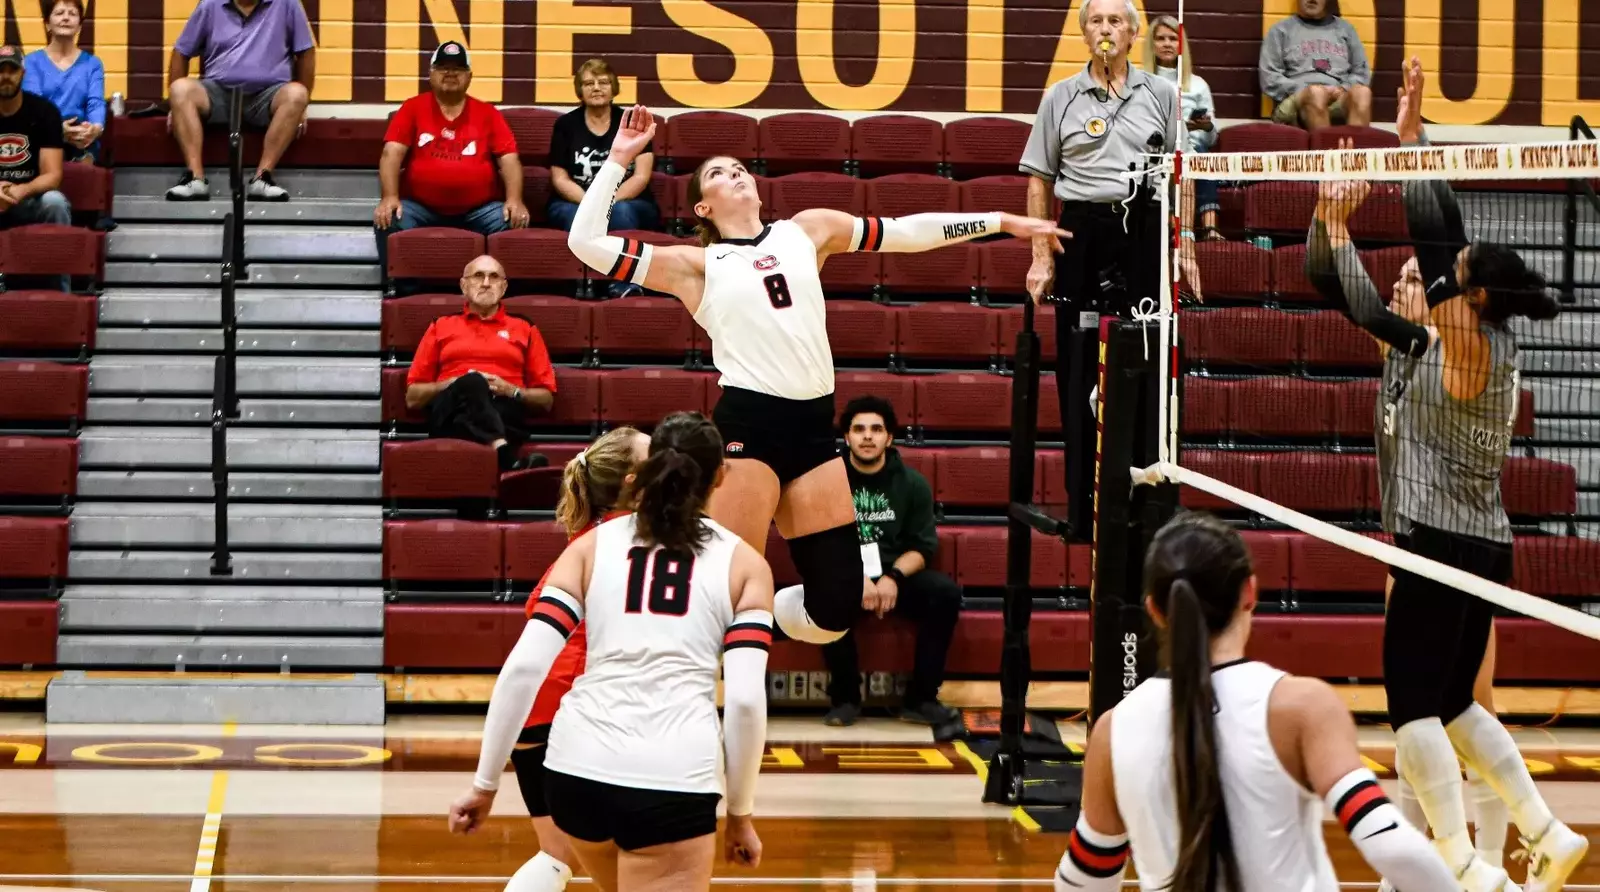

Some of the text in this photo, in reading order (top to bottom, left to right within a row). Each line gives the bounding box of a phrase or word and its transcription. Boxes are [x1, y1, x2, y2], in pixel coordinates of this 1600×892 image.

[0, 0, 1160, 111] MNESOT
[943, 220, 986, 240] HUSKIES
[763, 273, 793, 310] 8
[624, 545, 697, 617] 18
[1121, 632, 1138, 689] sports
